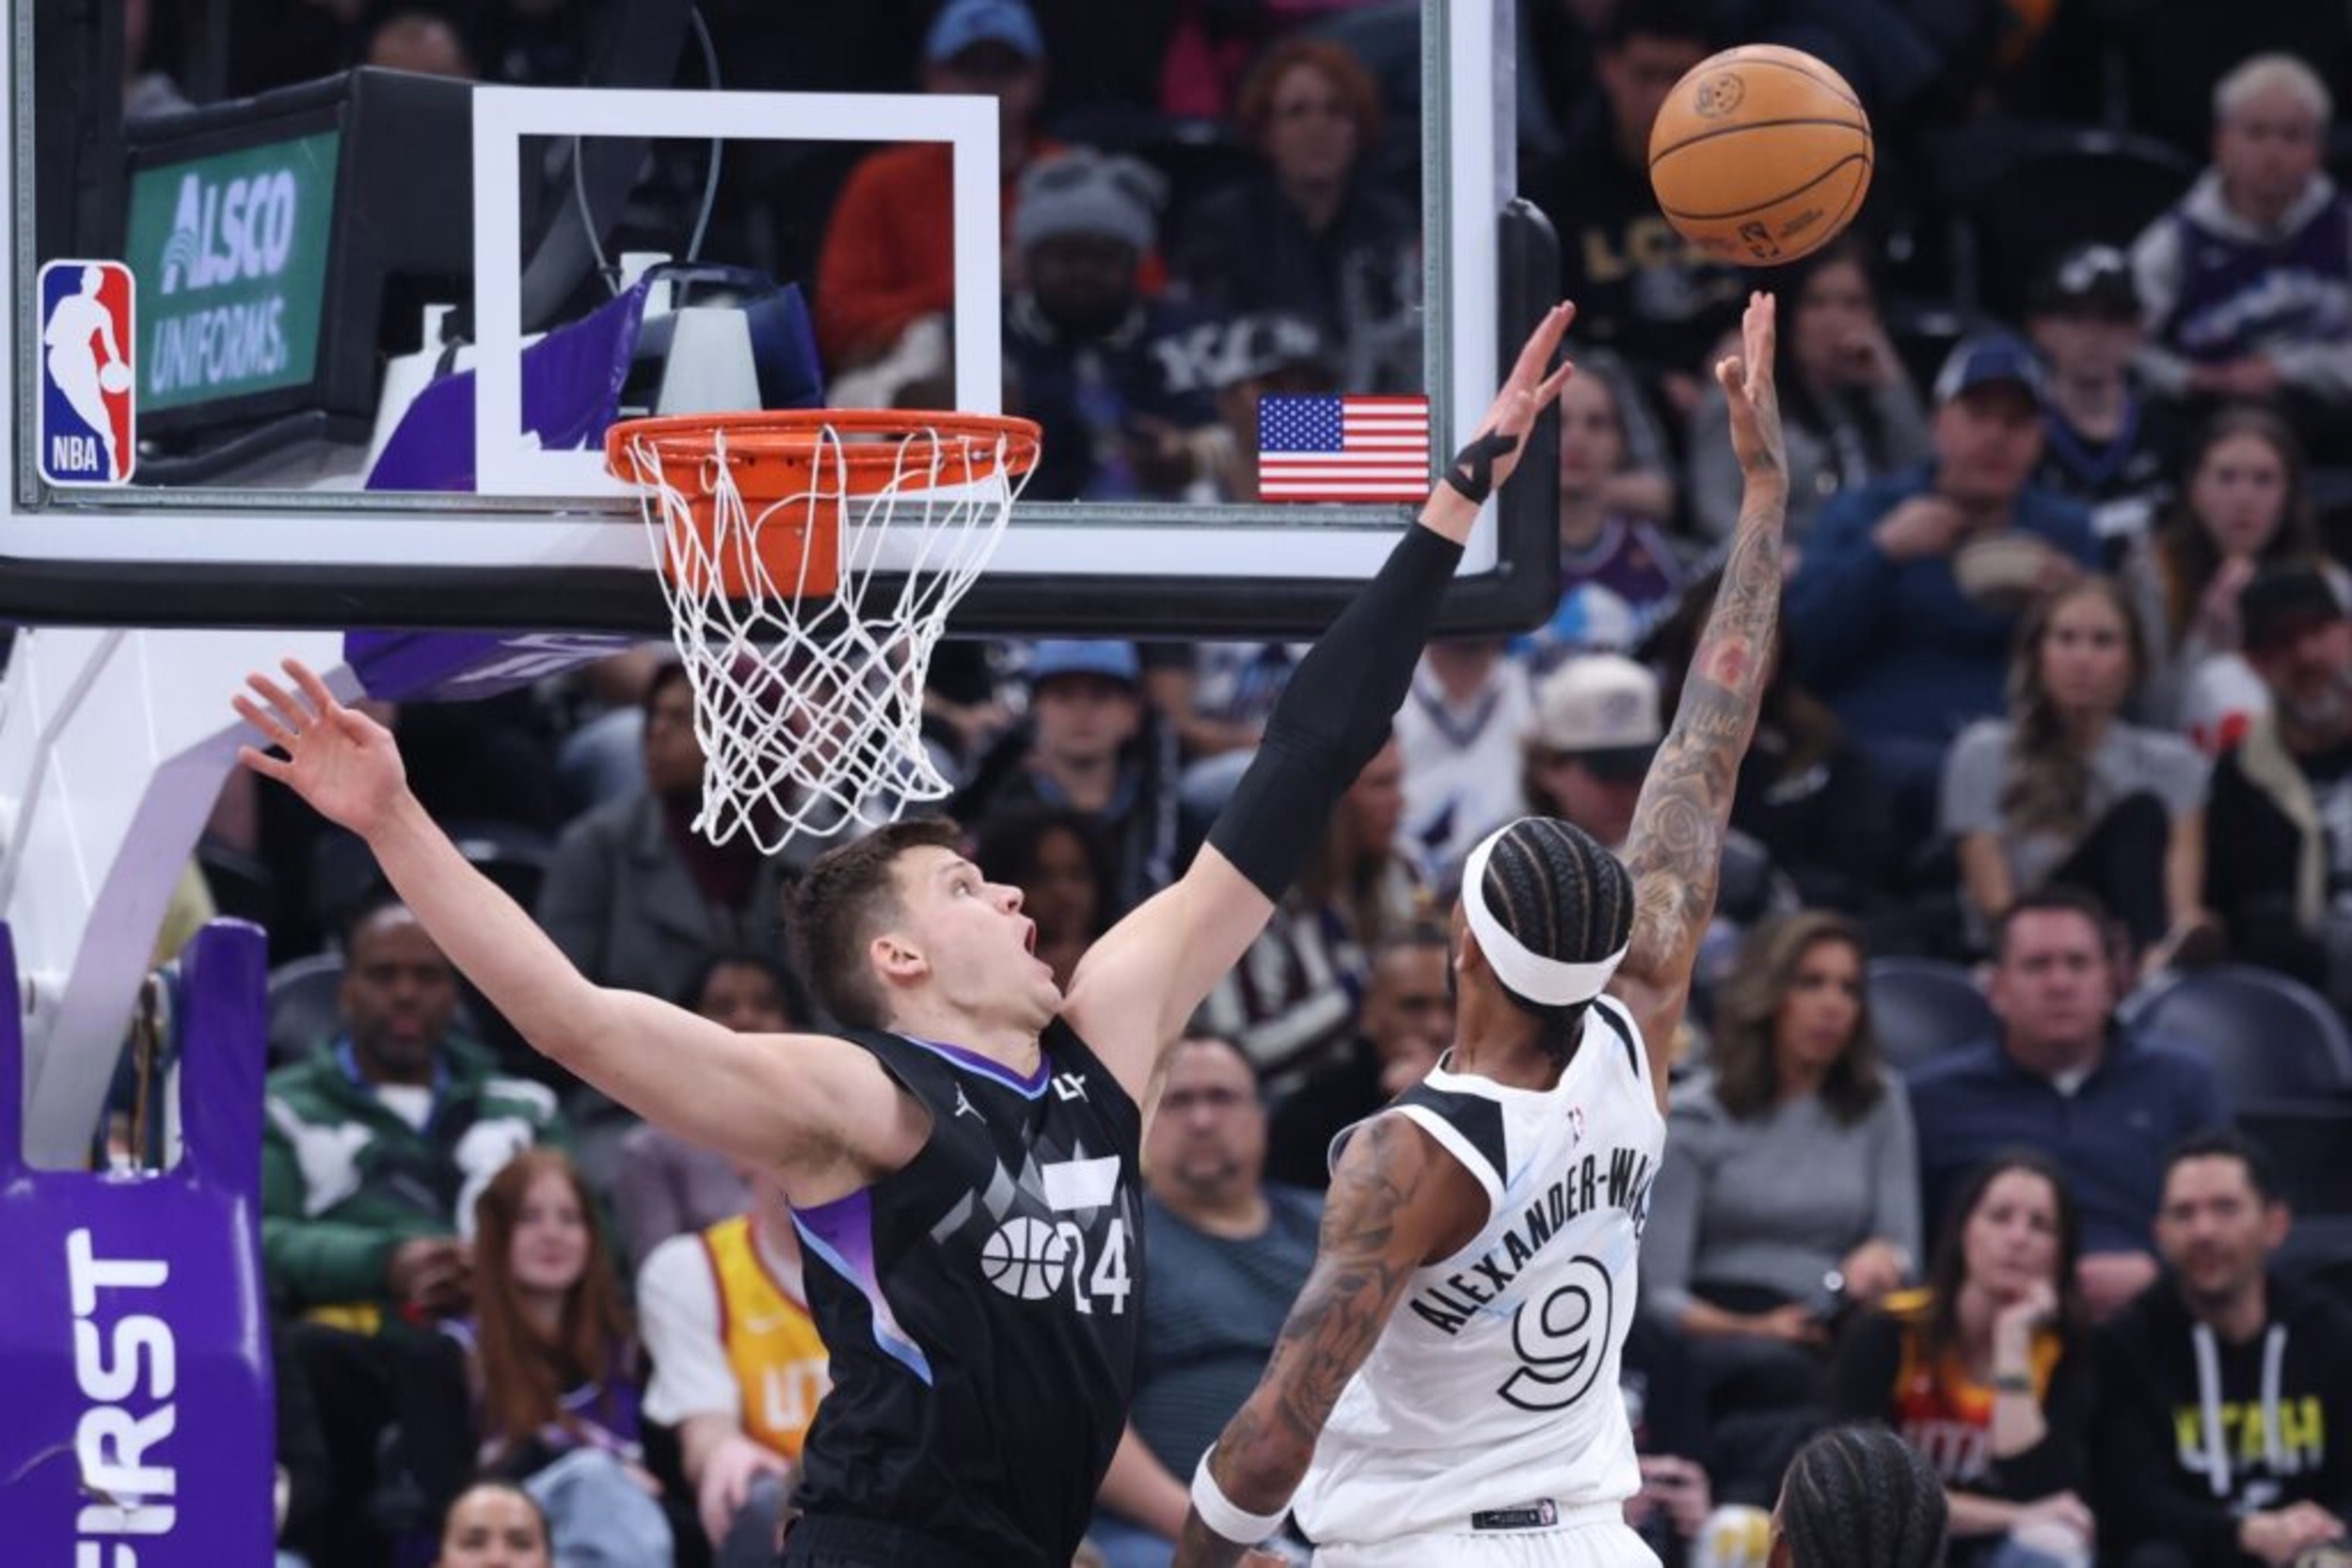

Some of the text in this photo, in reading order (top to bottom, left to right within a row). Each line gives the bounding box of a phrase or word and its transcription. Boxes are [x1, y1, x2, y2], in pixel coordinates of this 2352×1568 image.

[161, 169, 296, 294] ALSCO
[52, 436, 100, 471] NBA
[1056, 1218, 1131, 1315] 24
[1497, 1255, 1613, 1411] 9
